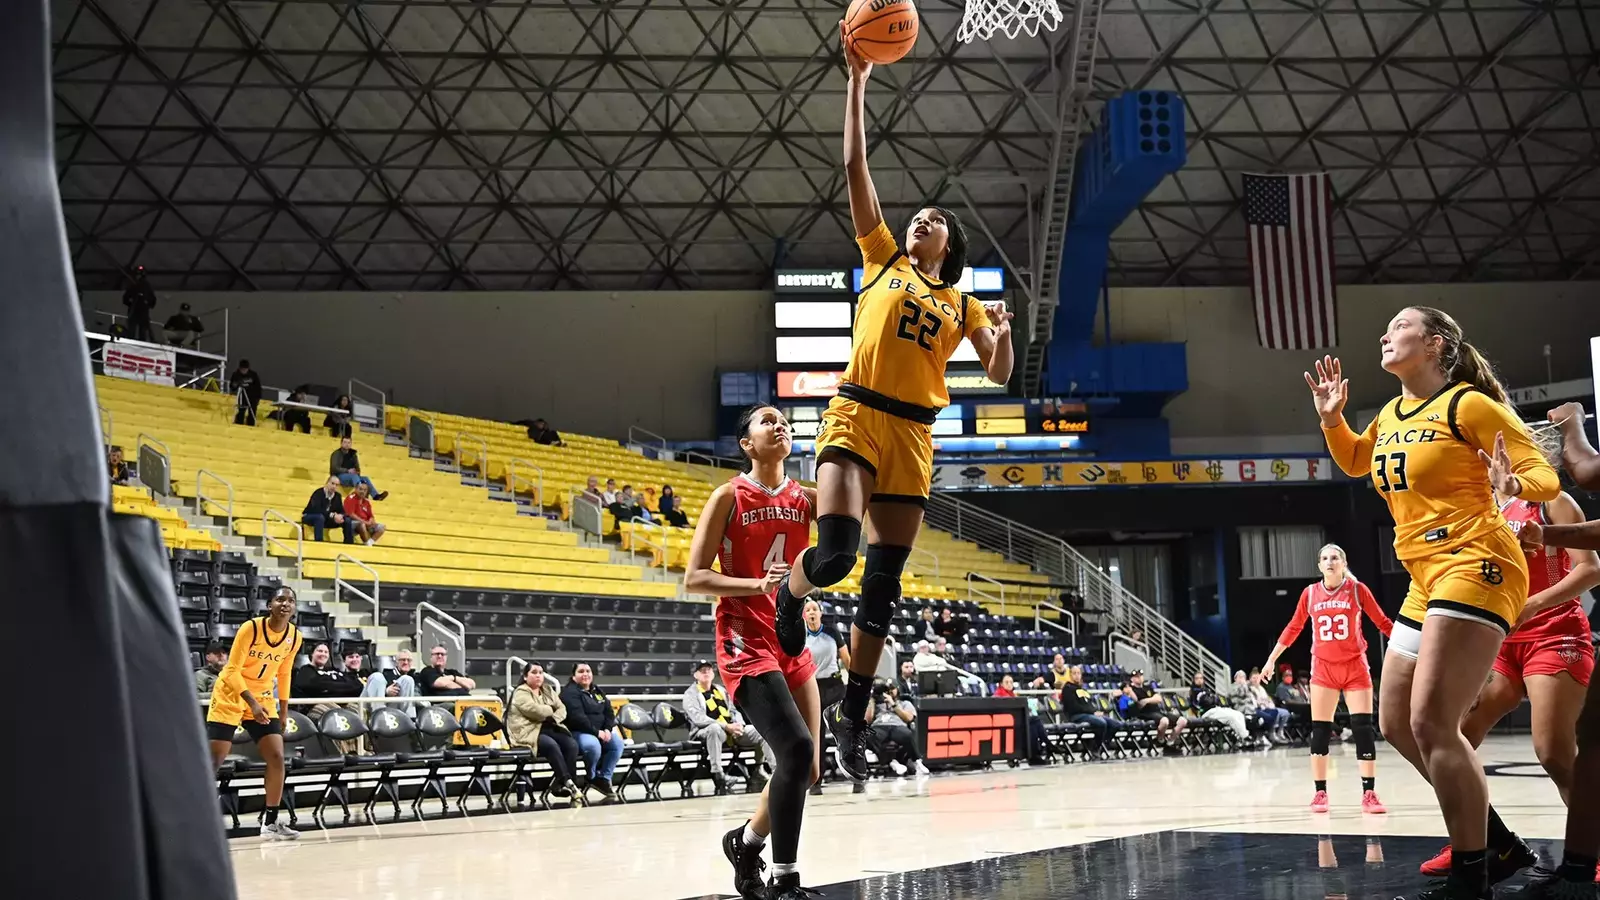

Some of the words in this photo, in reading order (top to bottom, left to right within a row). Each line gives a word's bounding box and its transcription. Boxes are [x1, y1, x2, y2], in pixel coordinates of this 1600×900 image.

[889, 278, 963, 328] BEACH
[897, 300, 943, 351] 22
[106, 349, 173, 377] ESPN
[1375, 429, 1437, 447] EACH
[1374, 451, 1409, 493] 33
[741, 506, 805, 526] BETHESDA
[763, 532, 788, 572] 4
[1313, 600, 1352, 613] BETHESDA
[1317, 614, 1349, 641] 23
[249, 650, 286, 662] BEAC
[257, 663, 268, 679] 1
[927, 713, 1015, 759] ESPN
